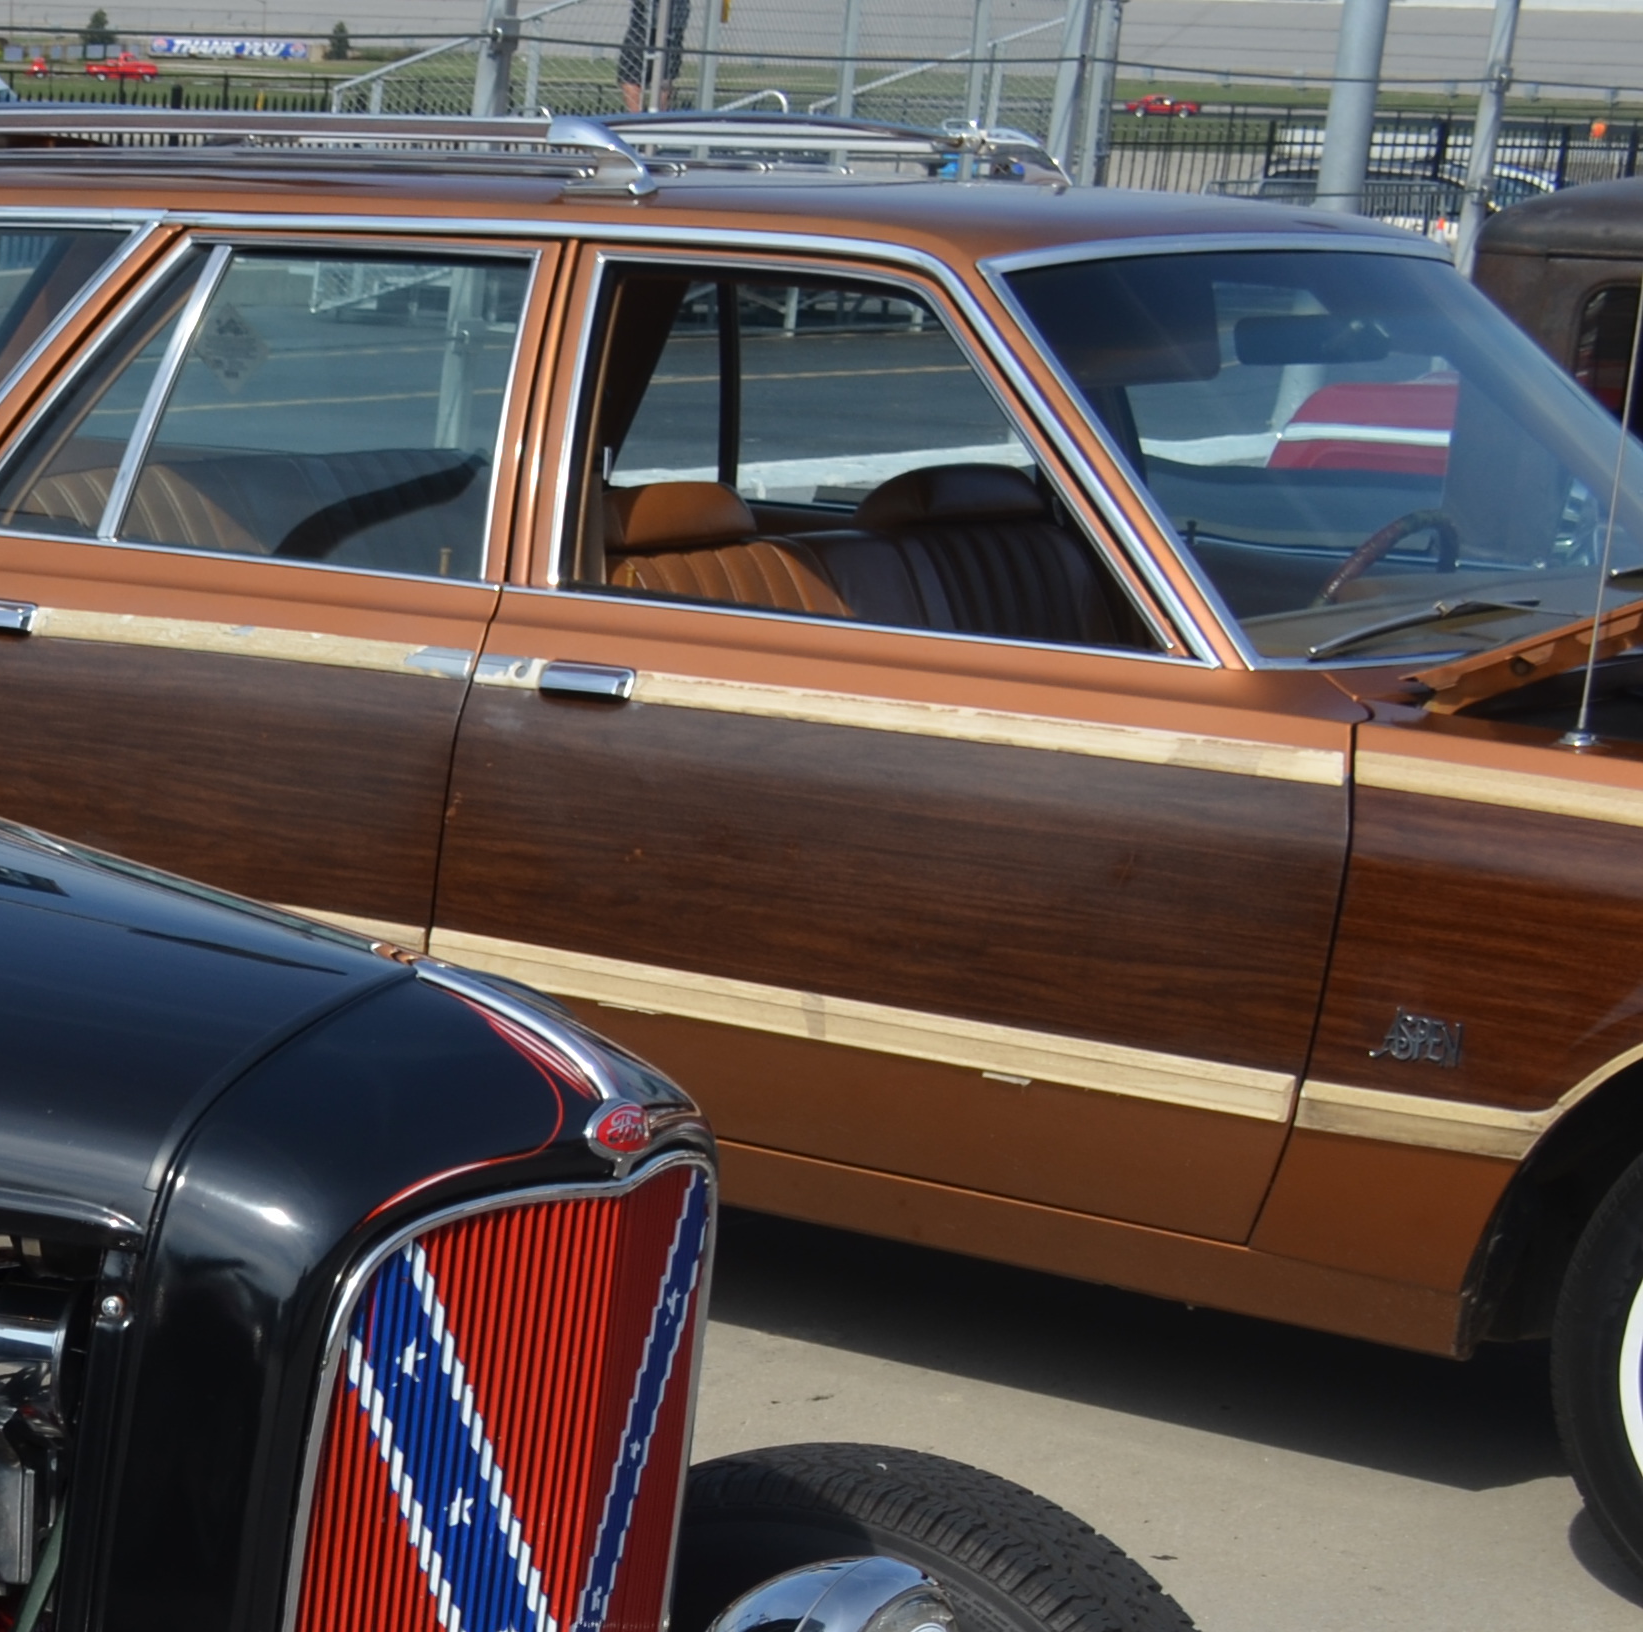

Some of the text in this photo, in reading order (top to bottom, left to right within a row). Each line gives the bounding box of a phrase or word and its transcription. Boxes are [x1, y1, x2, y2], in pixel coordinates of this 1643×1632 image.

[172, 38, 285, 55] THANK YOU
[1368, 1006, 1464, 1069] ASPEN
